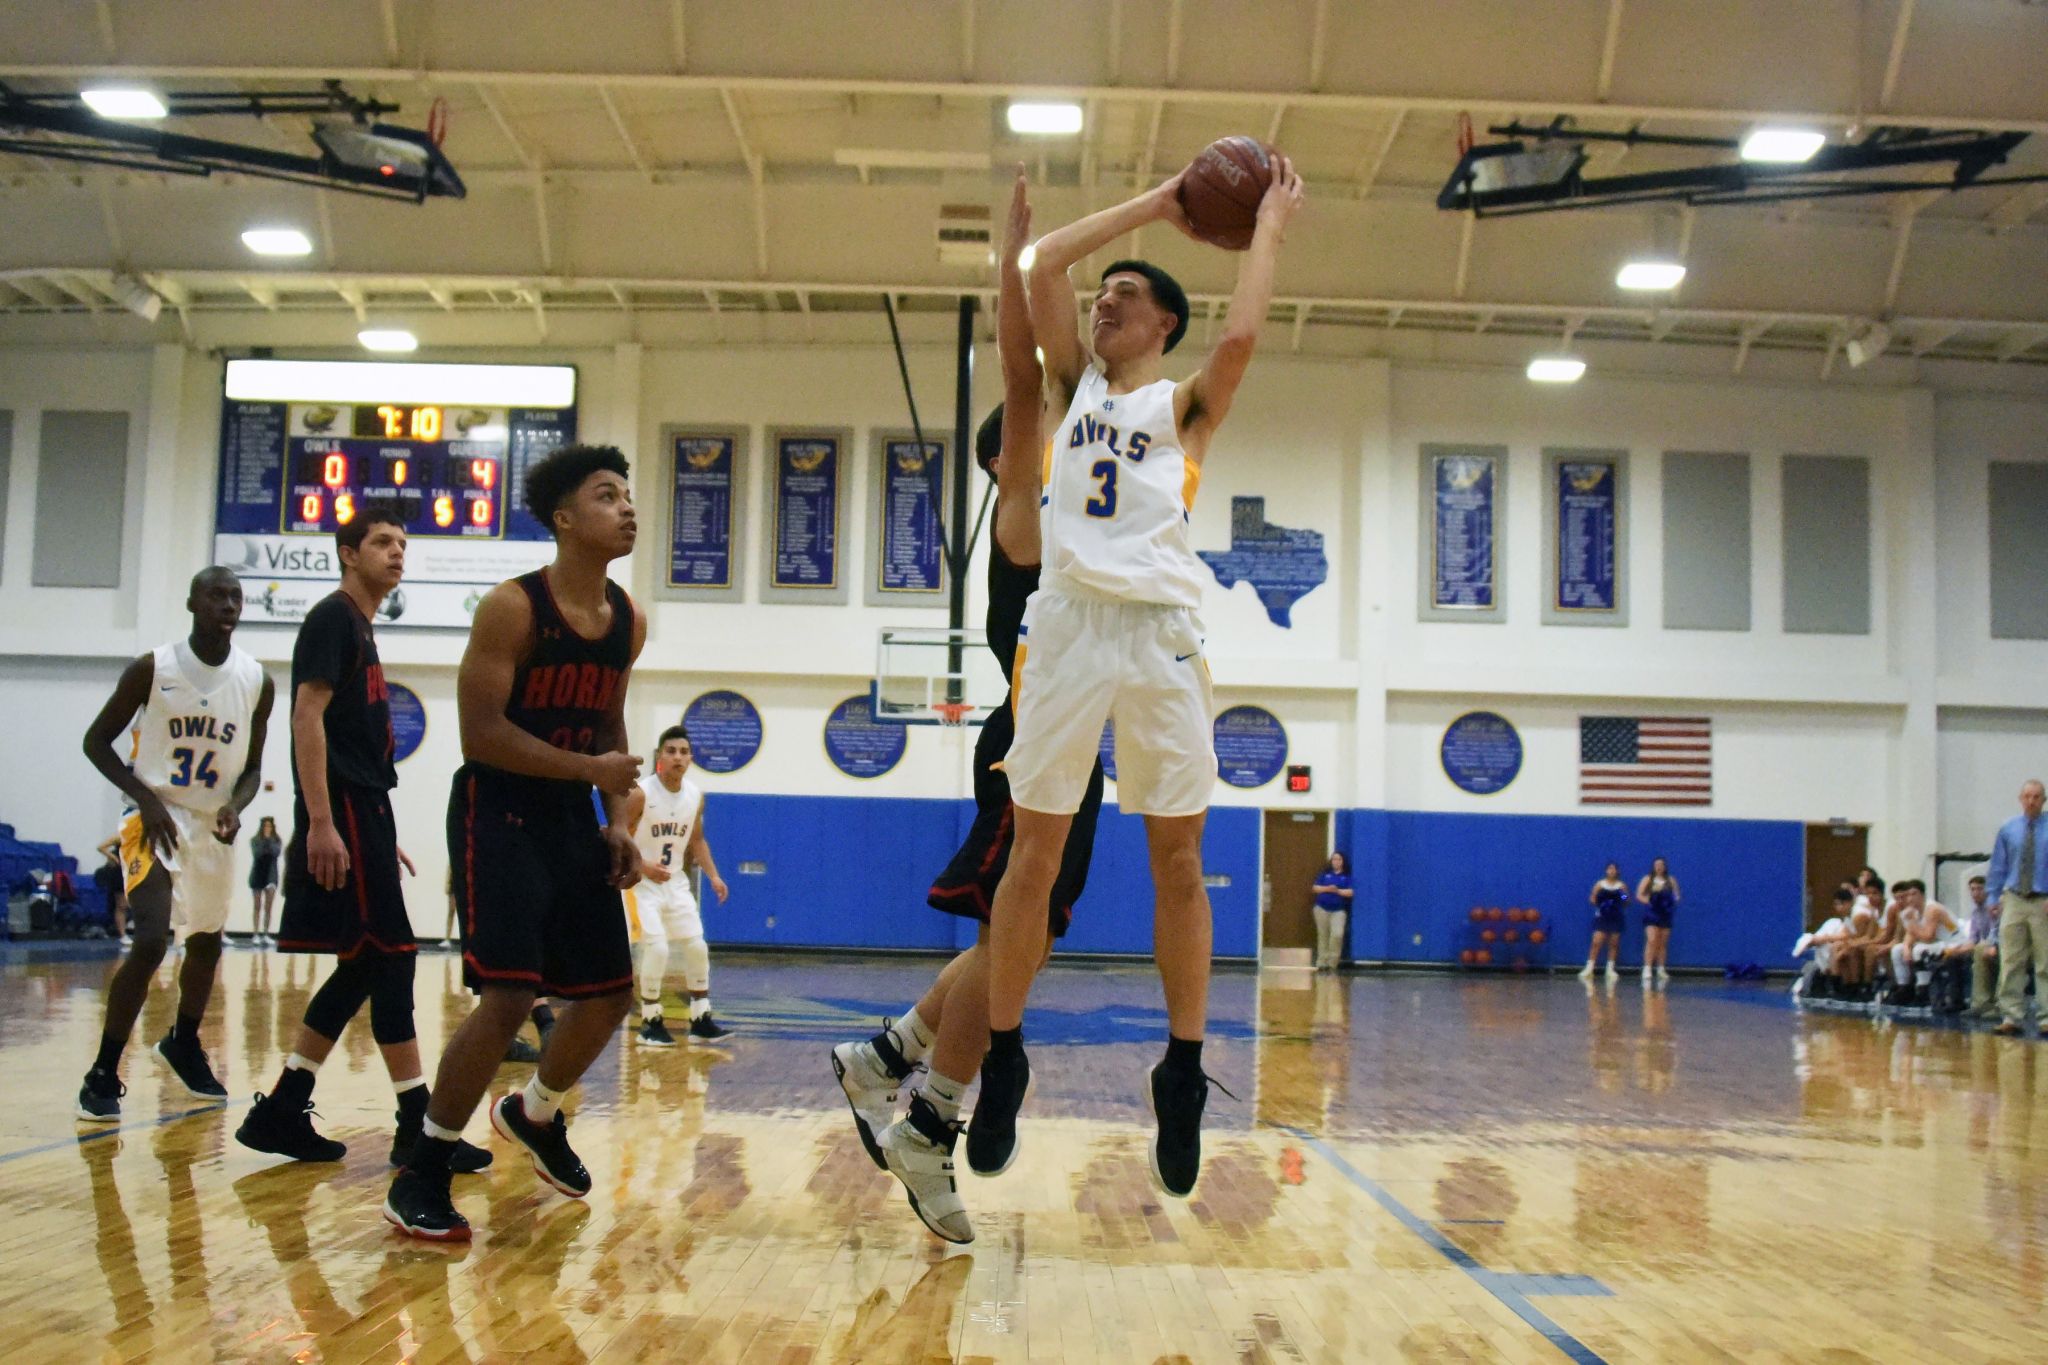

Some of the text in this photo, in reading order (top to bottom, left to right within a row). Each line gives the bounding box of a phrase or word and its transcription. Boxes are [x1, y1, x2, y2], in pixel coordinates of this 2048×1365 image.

[378, 405, 444, 442] 7:10
[1070, 412, 1151, 463] OWLS
[303, 439, 341, 453] OWLS
[324, 452, 347, 488] 0
[394, 459, 406, 486] 1
[472, 458, 496, 490] 4
[1086, 458, 1119, 520] 3
[302, 493, 322, 522] 0
[472, 497, 494, 528] 0
[264, 543, 330, 571] Vista
[168, 715, 237, 745] OWLS
[170, 747, 219, 789] 34
[651, 822, 688, 838] OWLS
[660, 843, 673, 866] 5
